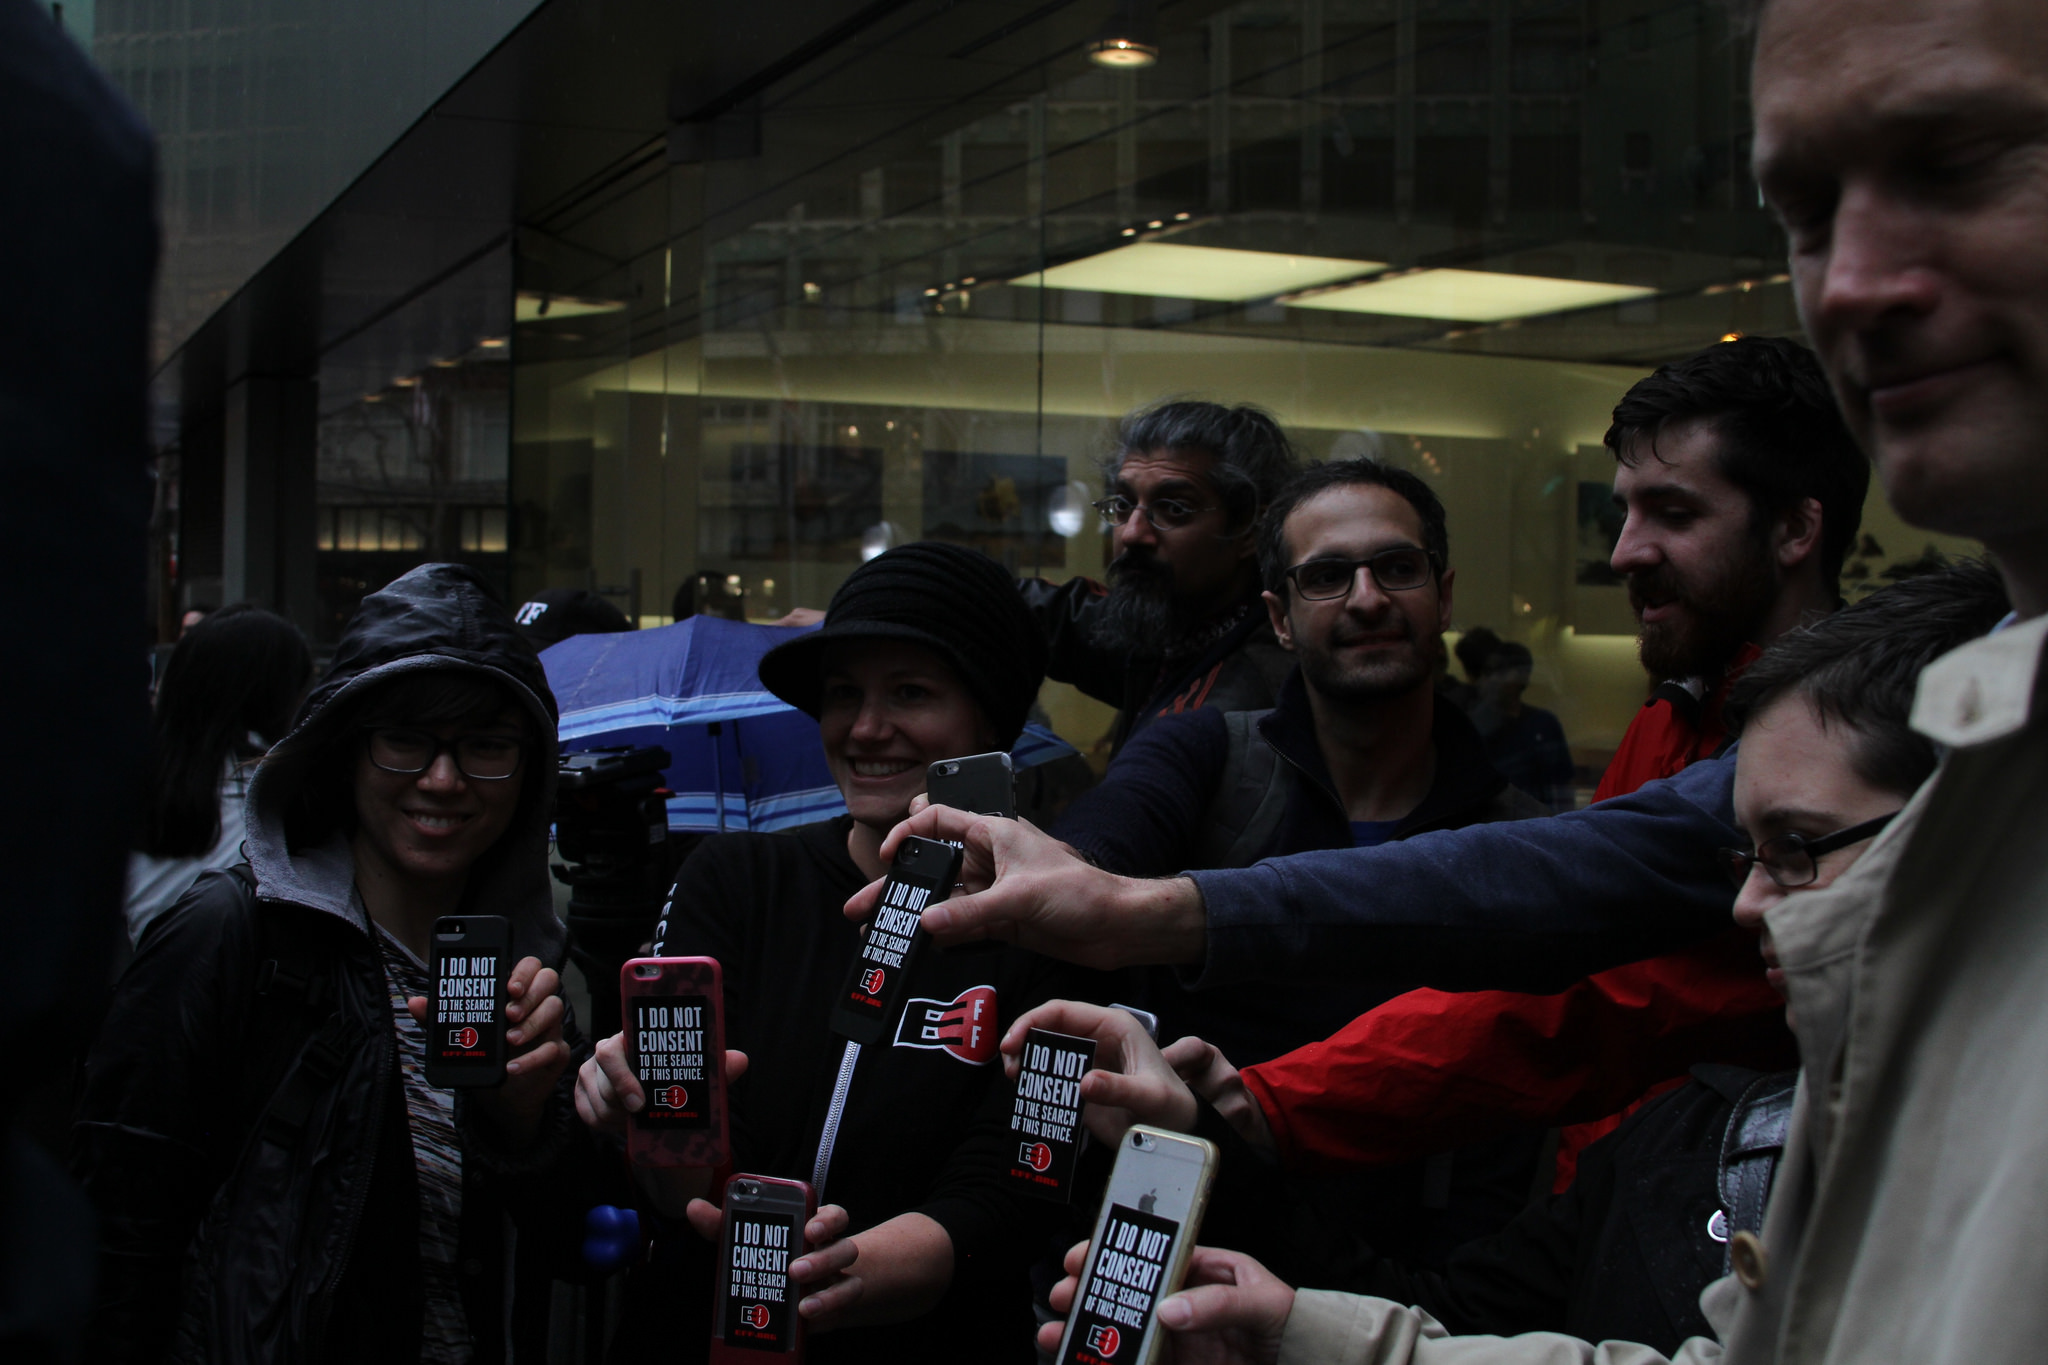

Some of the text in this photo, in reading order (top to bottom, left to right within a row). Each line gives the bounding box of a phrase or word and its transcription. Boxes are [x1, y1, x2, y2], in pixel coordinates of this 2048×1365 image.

[884, 880, 932, 912] I DO NOT
[874, 905, 921, 938] CONSENT
[440, 957, 497, 977] I DO NOT
[438, 978, 497, 998] CONSENT
[438, 999, 495, 1011] TO THE SEARCH
[438, 1012, 494, 1023] OF THIS DEVICE.
[638, 1006, 702, 1029] I DO NOT
[638, 1030, 704, 1052] CONSENT
[640, 1054, 704, 1067] TO THE SEARCH
[640, 1068, 704, 1080] OF THIS DEVICE.
[1023, 1041, 1088, 1080] I DO NOT
[1017, 1070, 1081, 1109] CONSENT
[1014, 1098, 1077, 1128] TO THE SEARCH
[1011, 1115, 1073, 1144] OF THIS DEVICE.
[734, 1221, 790, 1248] I DO NOT
[1105, 1218, 1171, 1262] I DO NOT
[732, 1245, 789, 1273] CONSENT
[1096, 1248, 1162, 1293] CONSENT
[730, 1283, 786, 1302] OF THIS DEVICE.
[732, 1269, 787, 1289] TO THE SEARCH
[1090, 1277, 1151, 1312] TO THE SEARCH
[1084, 1295, 1143, 1330] OF THIS DEVICE.
